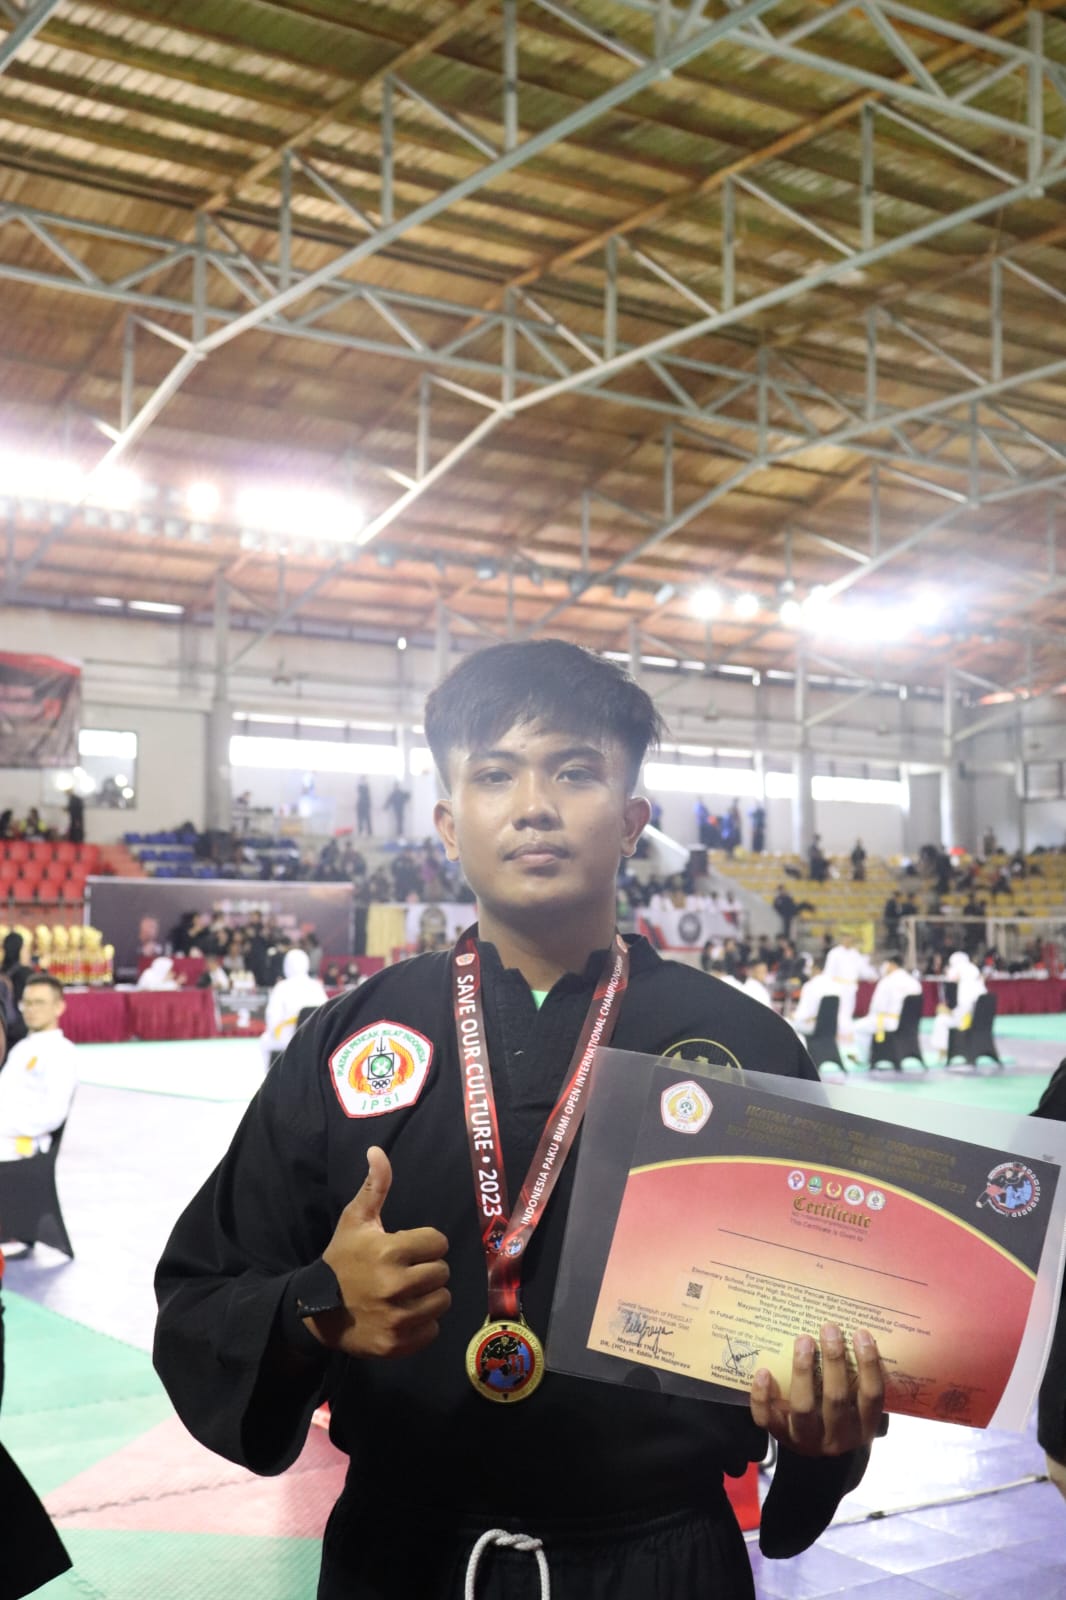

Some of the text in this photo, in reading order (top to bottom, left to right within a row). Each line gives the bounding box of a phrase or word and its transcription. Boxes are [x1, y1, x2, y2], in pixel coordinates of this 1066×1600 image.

[361, 1092, 399, 1110] IPSI
[457, 974, 503, 1217] SAVE OUR CULTURE 2023
[520, 955, 624, 1225] INDONESIA PAKU BUMI OPEN INTERNATIONAL CHAMPIONSHIP
[791, 1193, 873, 1228] Certificate
[839, 1299, 882, 1315] Championship
[851, 1317, 893, 1333] Championship
